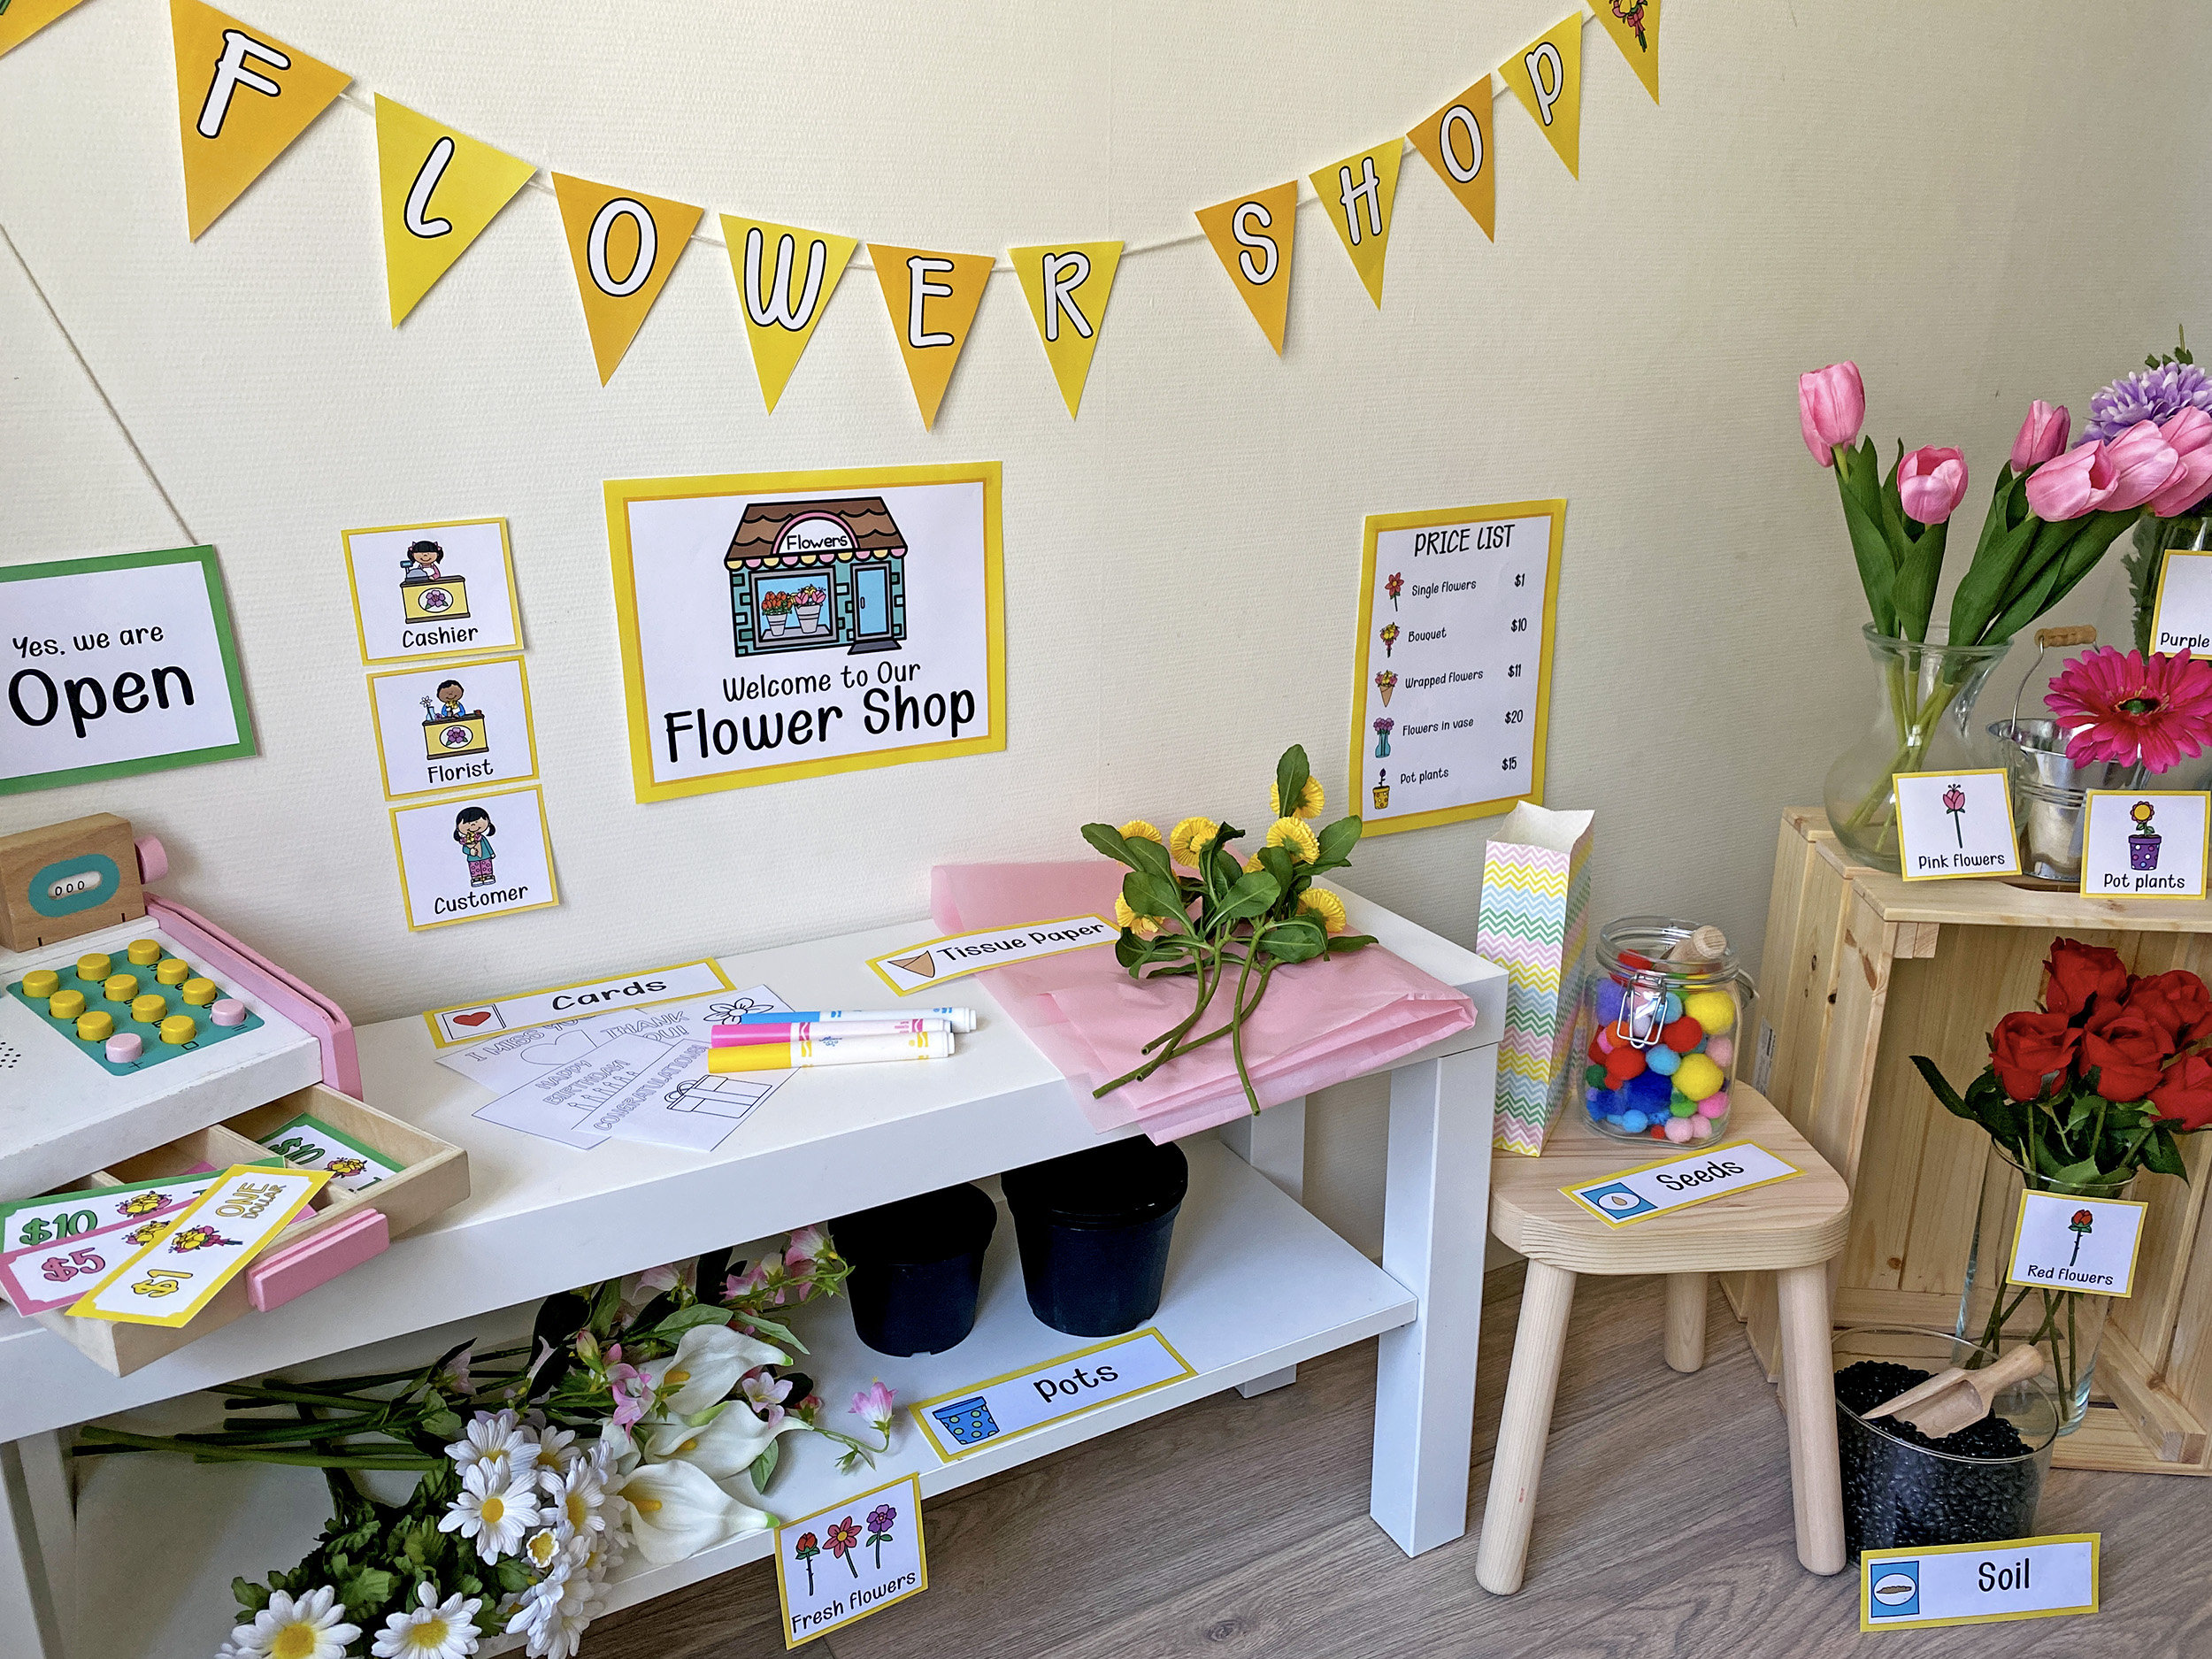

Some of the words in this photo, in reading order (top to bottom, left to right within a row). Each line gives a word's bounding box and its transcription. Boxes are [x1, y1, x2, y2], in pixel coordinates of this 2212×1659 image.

[787, 533, 849, 550] Flowers
[1414, 528, 1471, 557] PRICE
[1477, 524, 1516, 549] LIST
[1411, 584, 1440, 599] Single
[1441, 580, 1477, 592] flowers
[1514, 573, 1526, 588] $1
[73, 629, 111, 651] we
[119, 625, 165, 645] are
[402, 624, 479, 649] Cashier
[1408, 627, 1448, 644] Bouquet
[1510, 618, 1527, 633] $10
[2160, 632, 2210, 649] Purple
[723, 675, 832, 703] Welcome
[841, 664, 869, 688] to
[878, 660, 921, 684] Our
[1405, 673, 1447, 691] Wrapped
[1448, 669, 1484, 682] flowers
[1508, 664, 1523, 679] $11
[8, 664, 195, 738] Open
[664, 705, 843, 763] Flower
[864, 685, 976, 738] Shop
[1402, 723, 1440, 736] Flowers
[1441, 721, 1450, 731] in
[1453, 717, 1474, 728] vase
[1504, 709, 1524, 725] $20
[427, 758, 494, 784] Florist
[1400, 772, 1417, 785] Pot
[1419, 767, 1449, 784] plants
[1502, 757, 1517, 771] $15
[1918, 855, 1949, 870] Pink
[1953, 852, 2005, 867] flowers
[2103, 872, 2131, 888] Pot
[2135, 872, 2186, 890] plants
[434, 883, 529, 915] Customer
[937, 937, 1027, 961] Tissue
[1027, 923, 1105, 945] Paper
[552, 979, 667, 1010] Cards
[600, 1010, 690, 1039] THANK
[642, 1025, 690, 1042] OU!
[483, 1029, 545, 1056] MISS
[534, 1059, 593, 1089] HAPPY
[1655, 1161, 1745, 1191] Seeds
[215, 1182, 269, 1217] ONE
[241, 1184, 287, 1219] DOLLAR
[19, 1210, 98, 1246] $10
[41, 1247, 106, 1282] $5
[2027, 1264, 2055, 1279] Red
[2058, 1268, 2114, 1286] flowers
[131, 1268, 194, 1297] $1
[1033, 1363, 1118, 1402] Pots
[1978, 1558, 2031, 1593] Soil
[791, 1601, 844, 1633] Fresh
[849, 1571, 917, 1610] flowers
